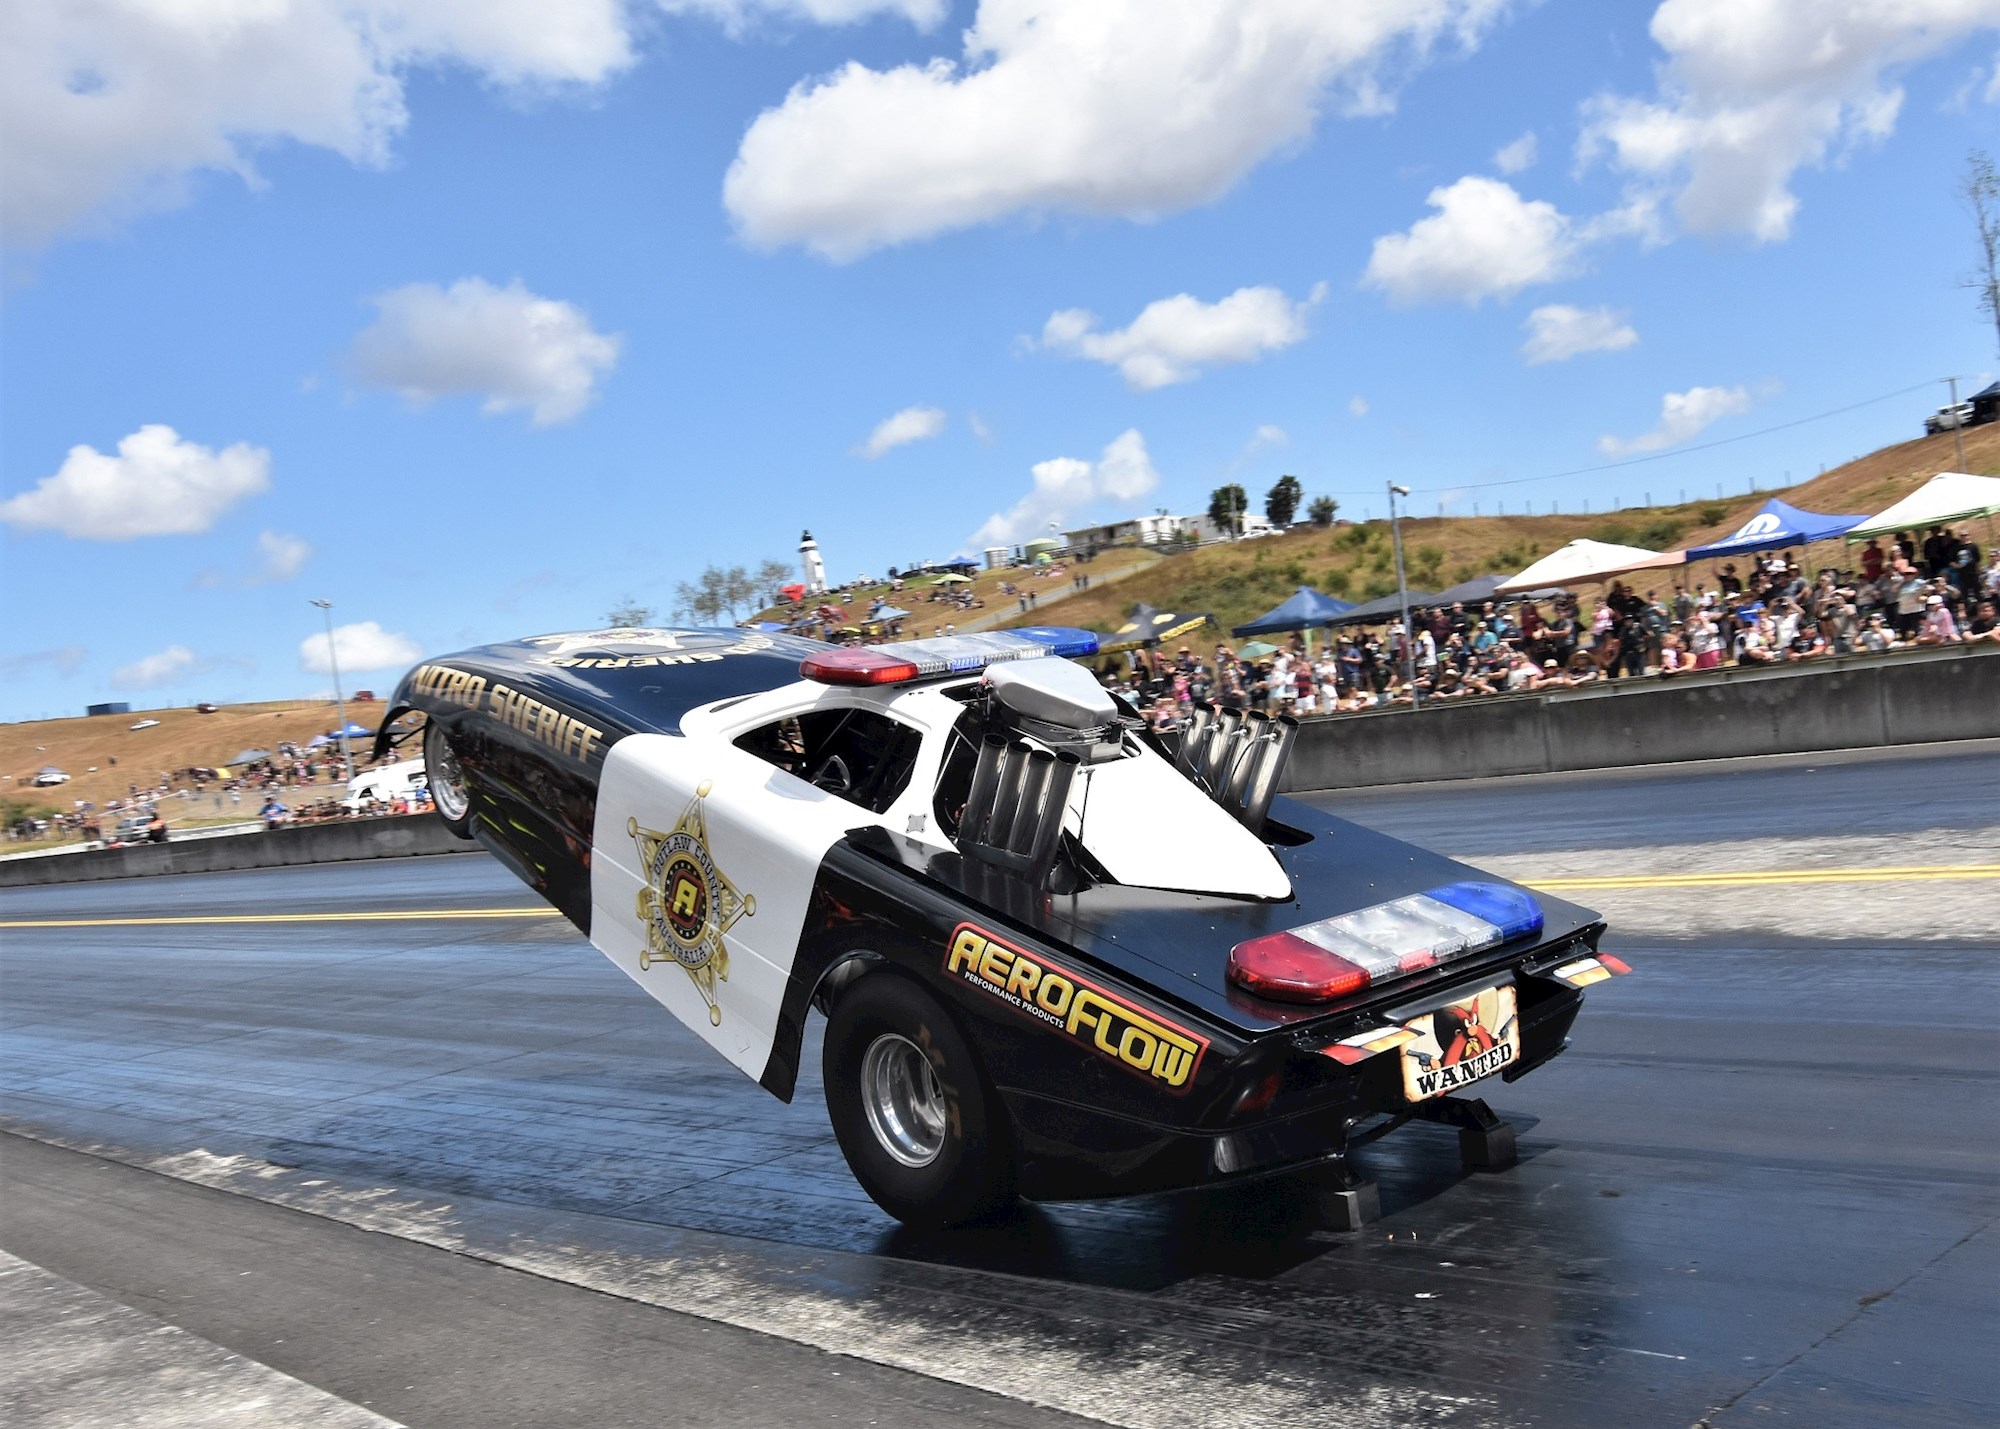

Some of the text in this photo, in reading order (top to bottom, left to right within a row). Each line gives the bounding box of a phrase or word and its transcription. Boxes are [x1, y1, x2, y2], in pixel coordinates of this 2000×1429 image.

[412, 665, 604, 764] NITRO SHERIFF
[654, 836, 720, 917] OUTLAW COUNTY
[655, 918, 707, 964] AUSTRALIA
[947, 929, 1199, 1087] AEROFLOW
[964, 971, 1065, 1029] PERFORMANCE PRODUCTS
[1416, 1042, 1513, 1095] WANTED
